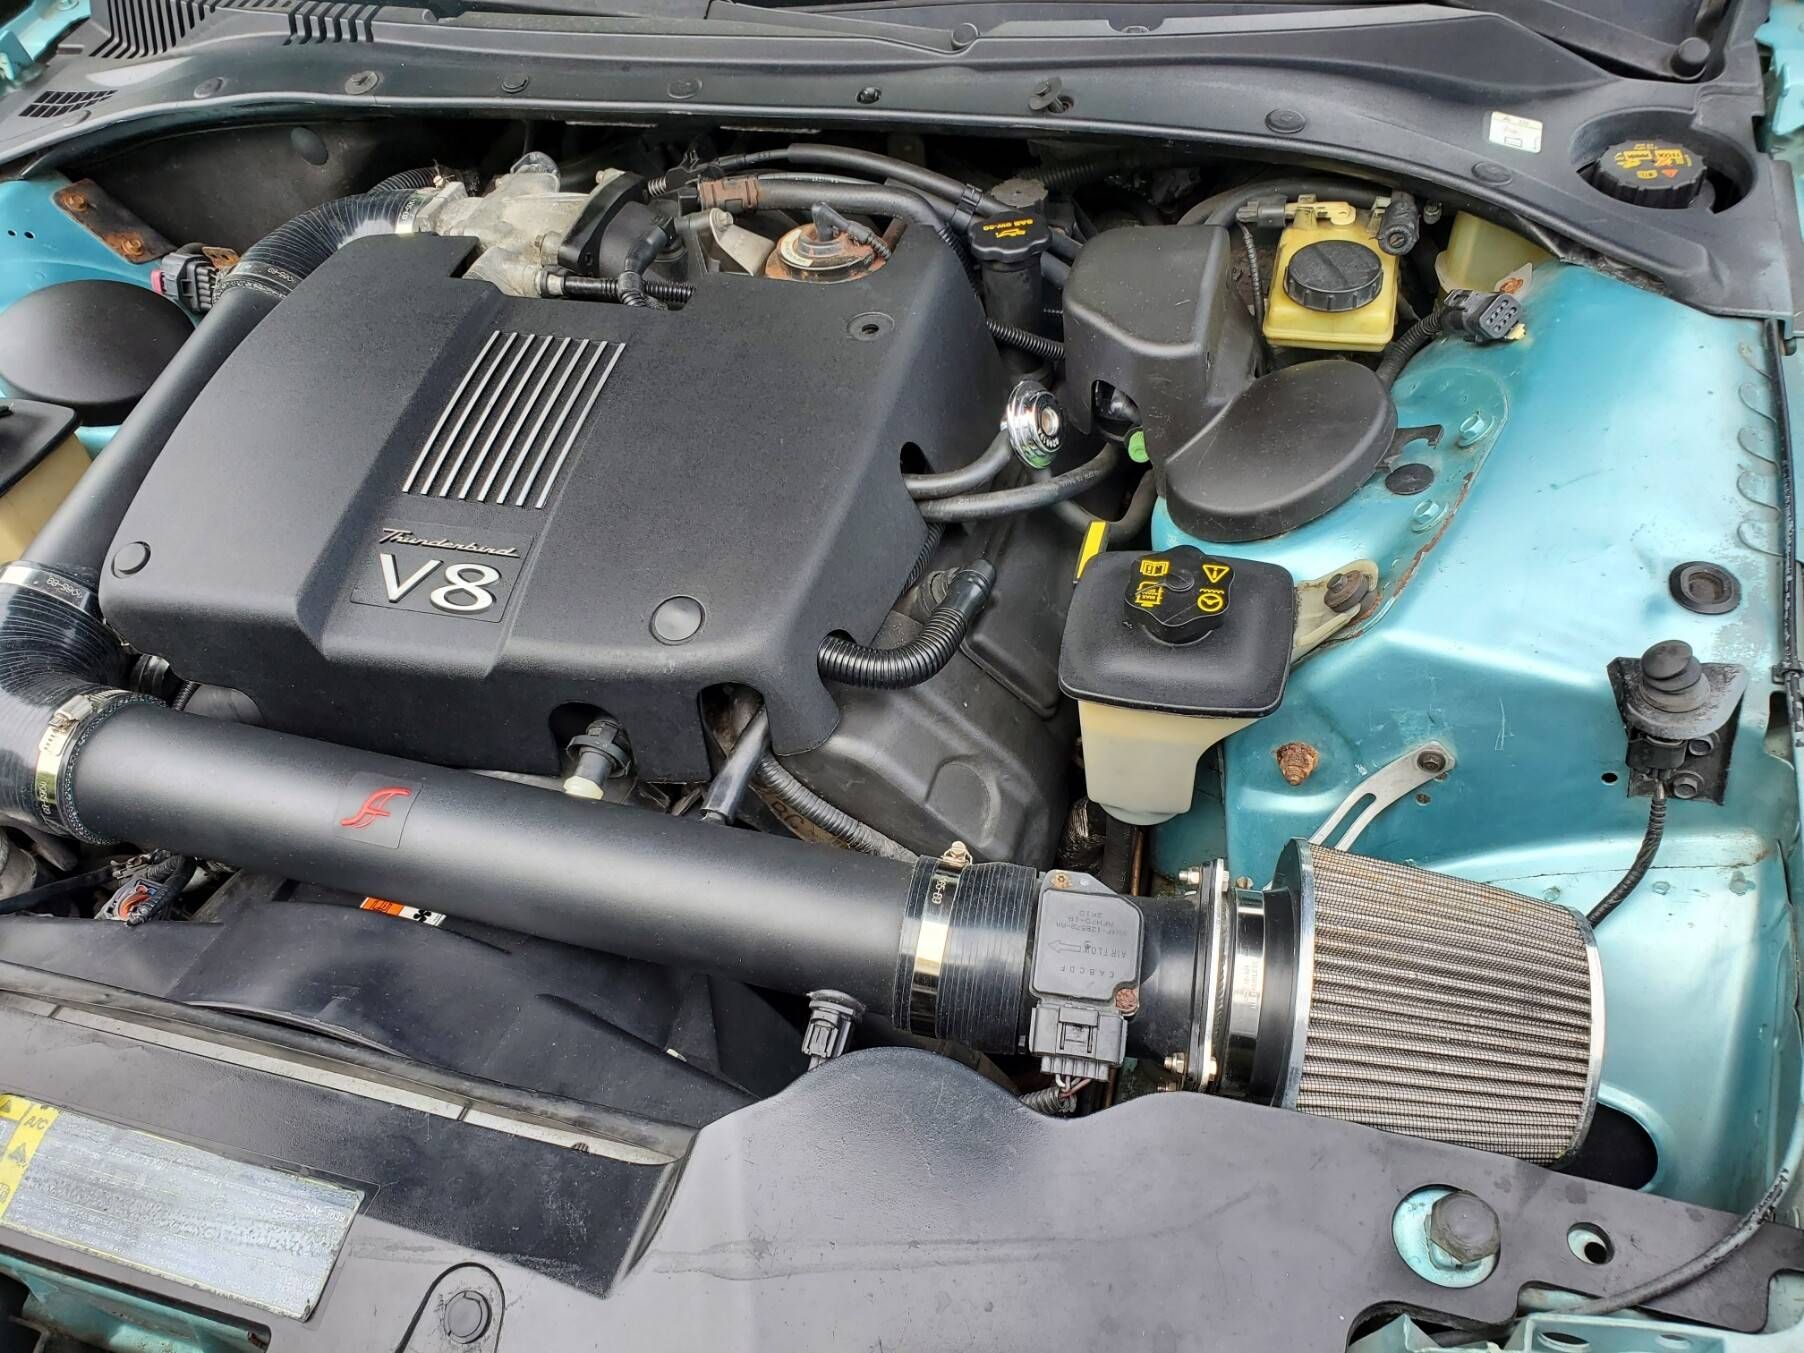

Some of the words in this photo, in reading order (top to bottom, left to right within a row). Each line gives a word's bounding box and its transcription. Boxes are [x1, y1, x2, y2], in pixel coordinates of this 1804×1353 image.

[379, 527, 520, 558] Thunderbird
[380, 553, 502, 614] V8
[24, 1115, 49, 1130] A/C
